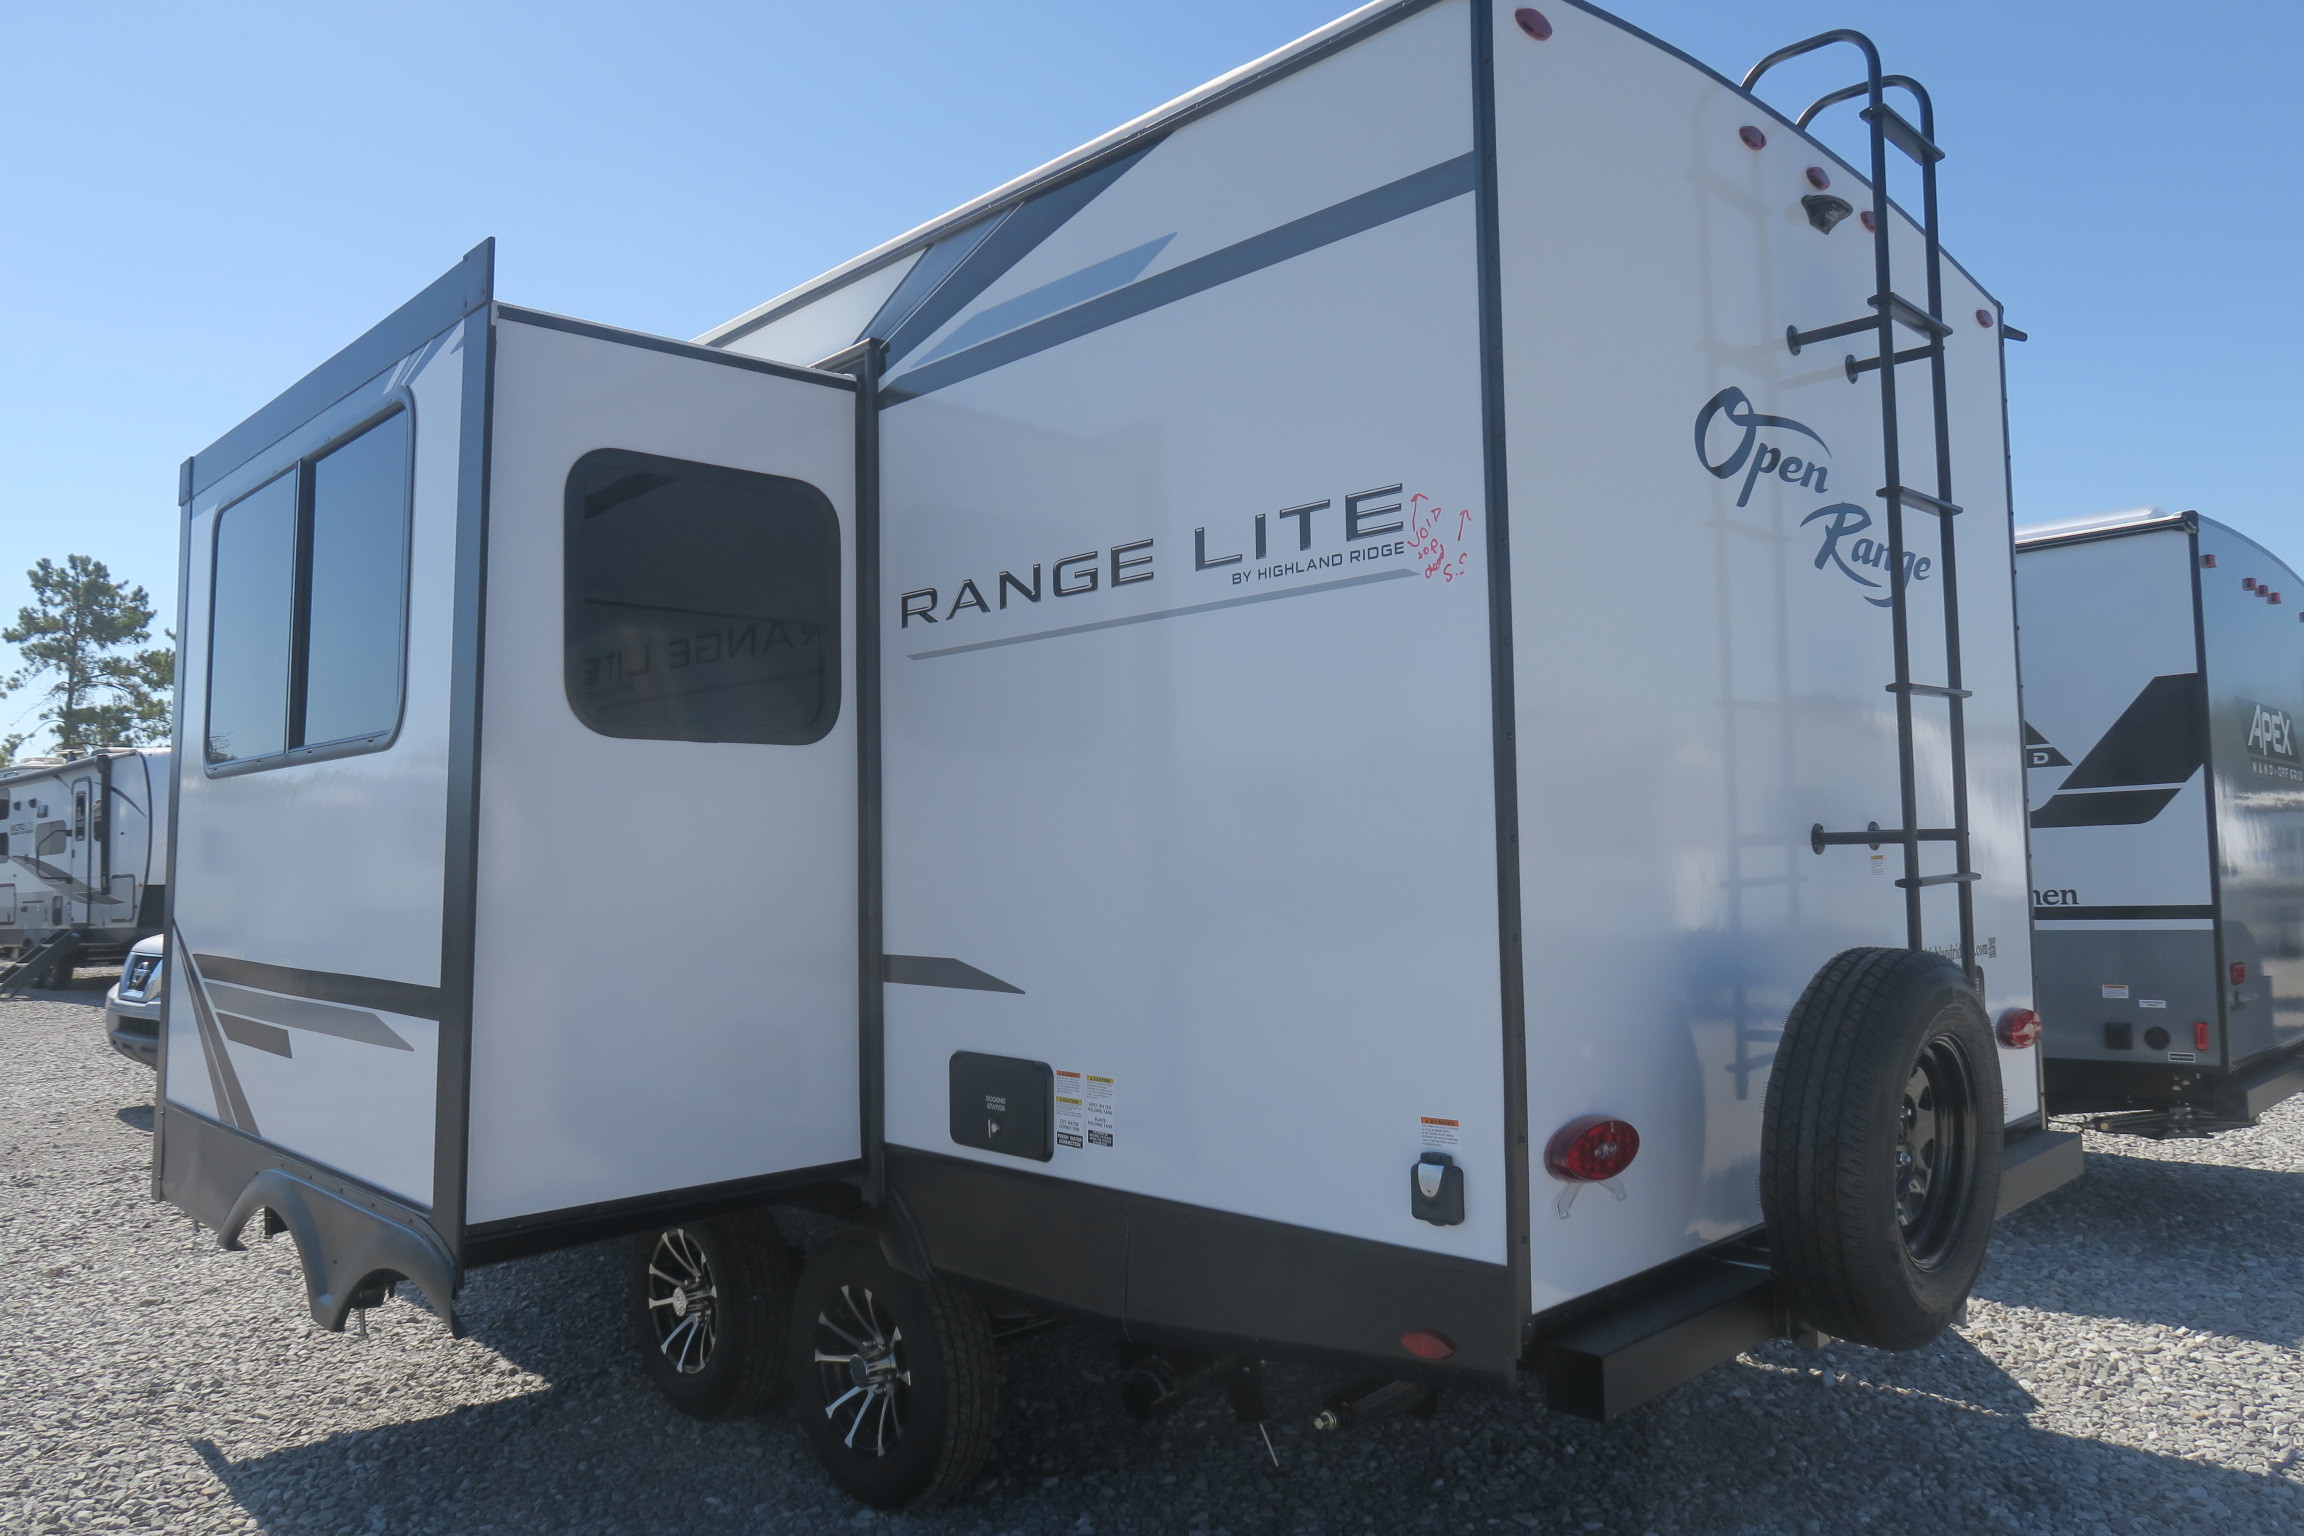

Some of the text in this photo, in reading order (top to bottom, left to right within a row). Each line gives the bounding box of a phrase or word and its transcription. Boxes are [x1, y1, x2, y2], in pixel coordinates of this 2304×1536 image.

[1694, 386, 1832, 507] Open
[901, 483, 1403, 629] RANGE LITE
[1232, 541, 1405, 585] BY HIGHLAND RIDGE
[2248, 703, 2292, 756] APEX
